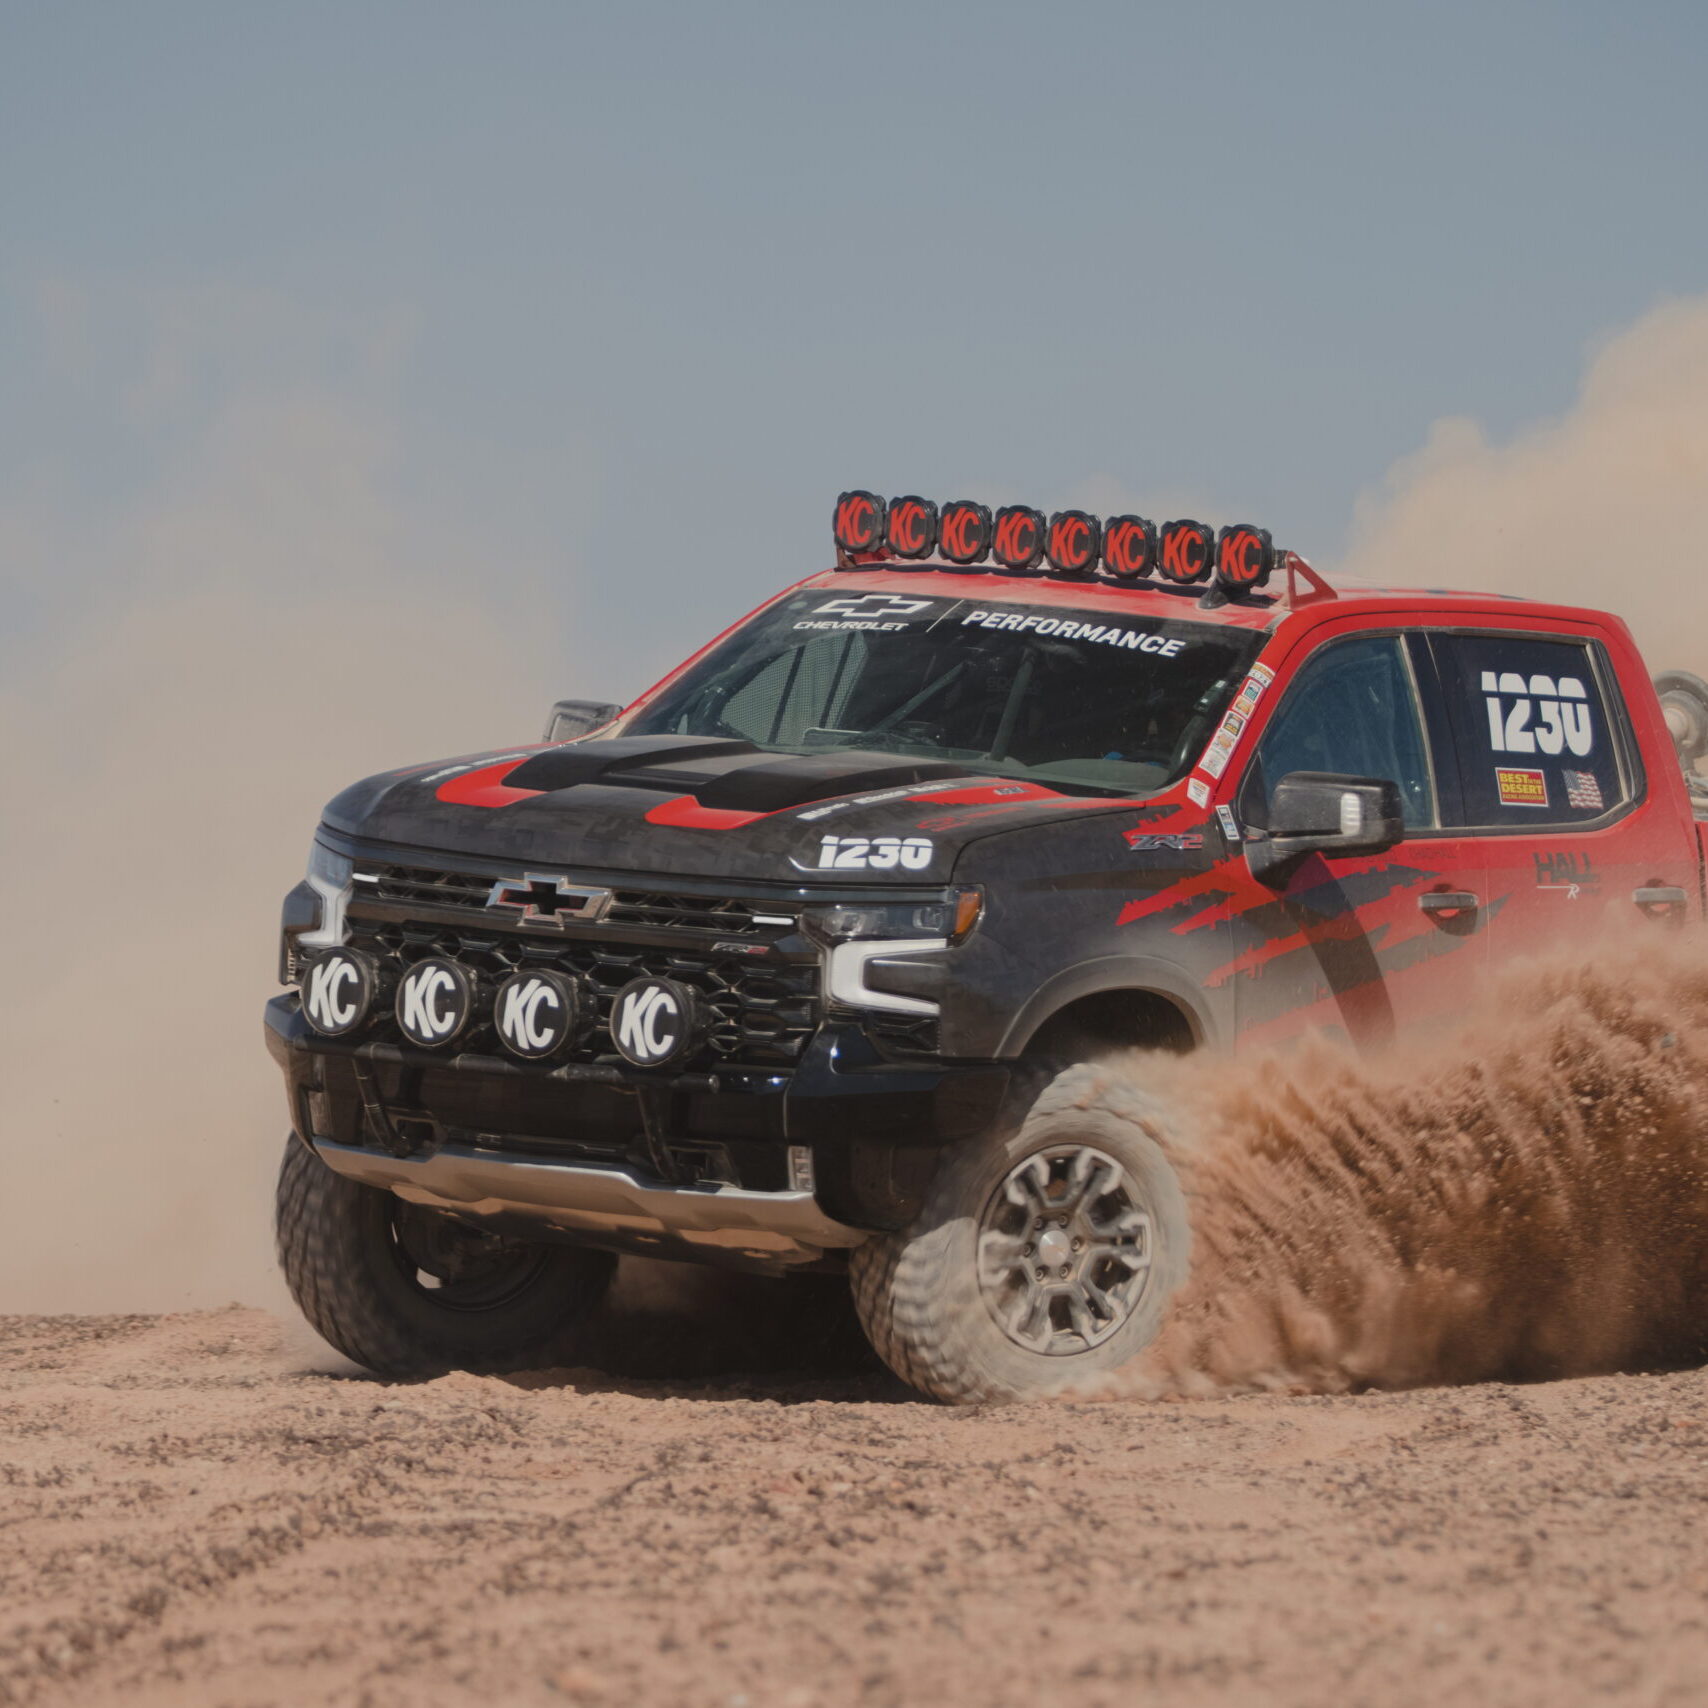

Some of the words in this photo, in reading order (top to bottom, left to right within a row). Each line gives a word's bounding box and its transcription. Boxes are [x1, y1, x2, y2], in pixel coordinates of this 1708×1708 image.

[837, 497, 872, 545] KC
[890, 502, 925, 550] KC
[943, 508, 979, 556] KC
[996, 512, 1034, 561] KC
[1051, 517, 1088, 567] KC
[1106, 522, 1144, 571] KC
[1163, 527, 1202, 576] KC
[1221, 531, 1260, 580] KC
[793, 621, 909, 631] CHEVROLET
[961, 610, 1186, 657] PERFORMANCE
[1481, 671, 1592, 757] 1230
[1500, 773, 1528, 784] BEST
[1501, 784, 1542, 795] DESERT
[817, 835, 933, 870] 1230
[308, 957, 358, 1028] KC
[404, 965, 456, 1038] KC
[503, 975, 556, 1049] KC
[620, 987, 678, 1059] KC
